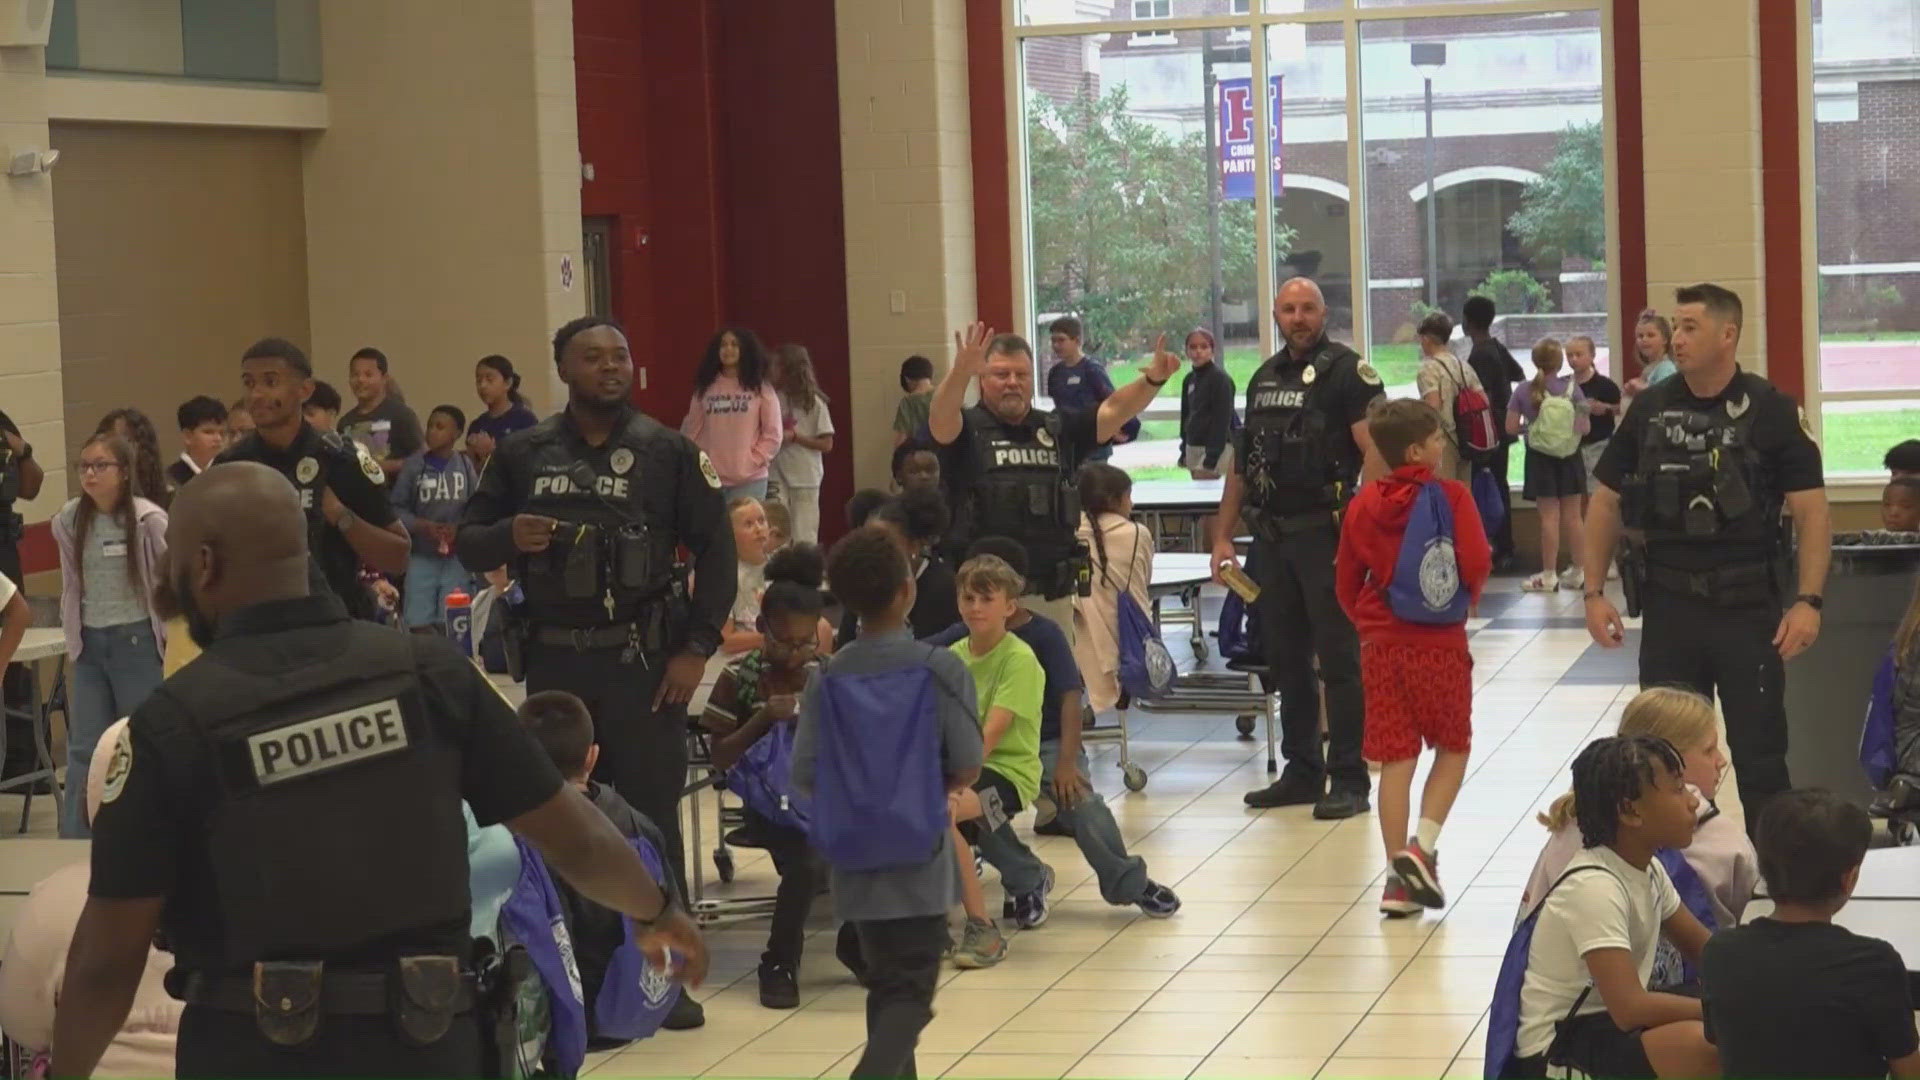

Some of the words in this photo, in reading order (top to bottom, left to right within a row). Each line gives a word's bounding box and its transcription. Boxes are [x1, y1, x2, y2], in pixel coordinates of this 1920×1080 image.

[1223, 157, 1282, 174] PANTS
[1254, 390, 1305, 409] POLICE
[995, 448, 1058, 466] POLICE
[534, 475, 629, 498] POLCE
[259, 709, 399, 775] POLICE
